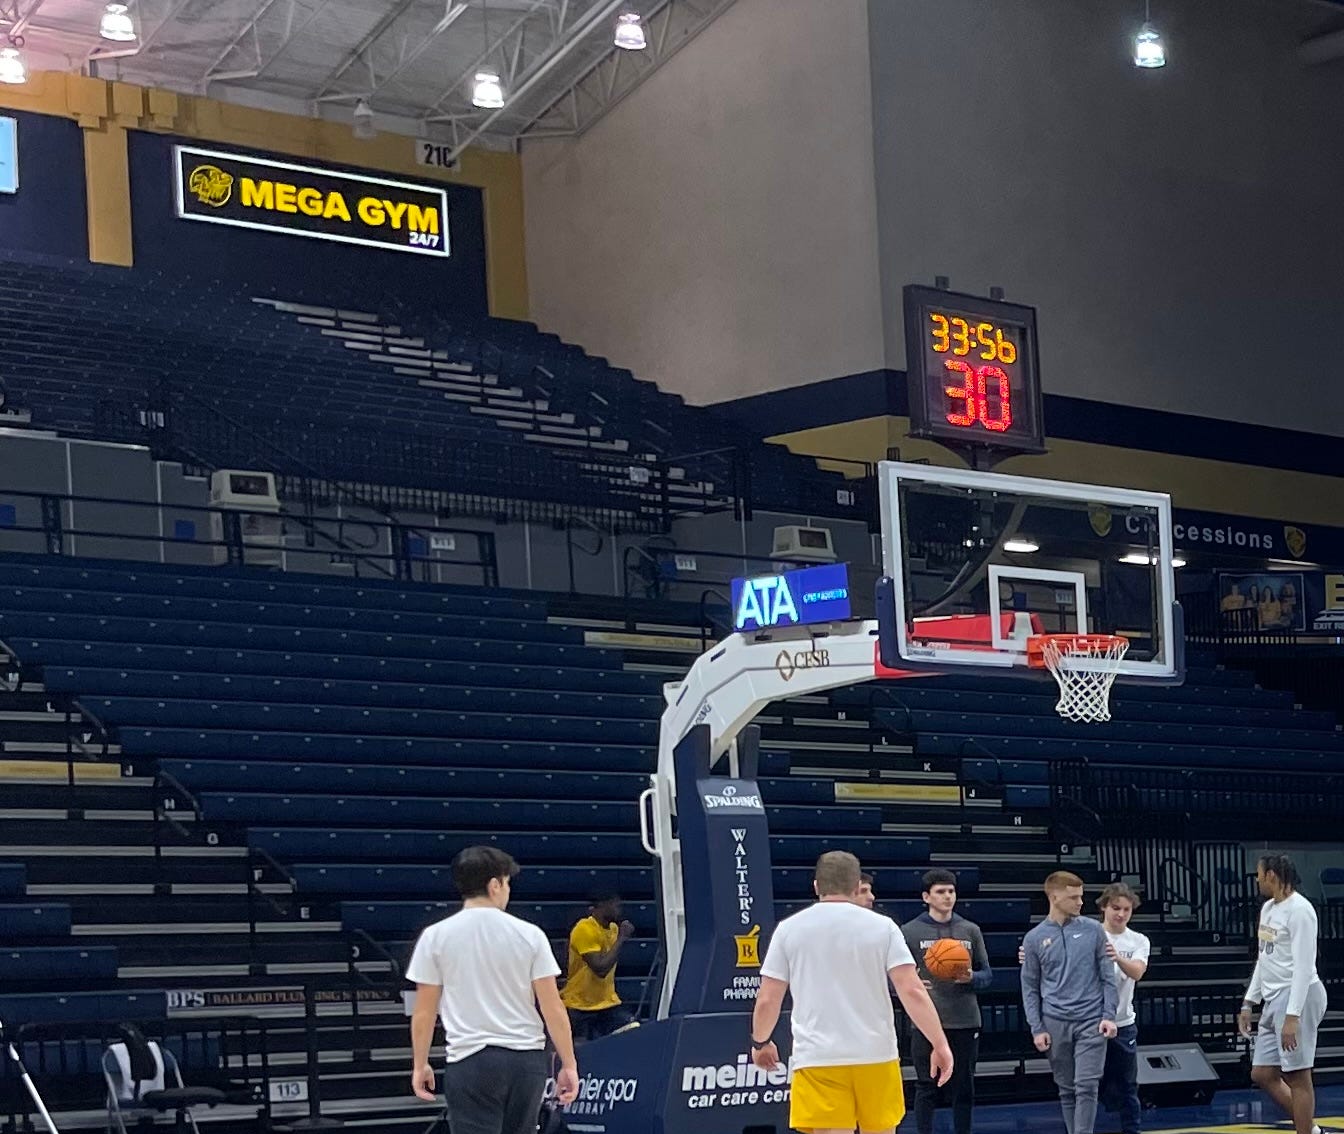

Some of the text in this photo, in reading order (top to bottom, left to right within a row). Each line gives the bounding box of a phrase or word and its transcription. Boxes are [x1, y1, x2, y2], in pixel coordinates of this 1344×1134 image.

[240, 177, 438, 234] MEGA GYM
[409, 231, 439, 248] 24/7
[930, 312, 1017, 365] 33:56
[944, 359, 1013, 432] 30
[736, 575, 799, 629] ATA
[793, 650, 830, 668] CFSB
[164, 799, 175, 809] H
[704, 794, 764, 810] SPALDING
[167, 990, 206, 1007] BPS
[682, 1054, 791, 1092] meine
[276, 1084, 300, 1096] 113
[605, 1078, 637, 1111] spa
[688, 1092, 715, 1108] car
[720, 1090, 759, 1106] care
